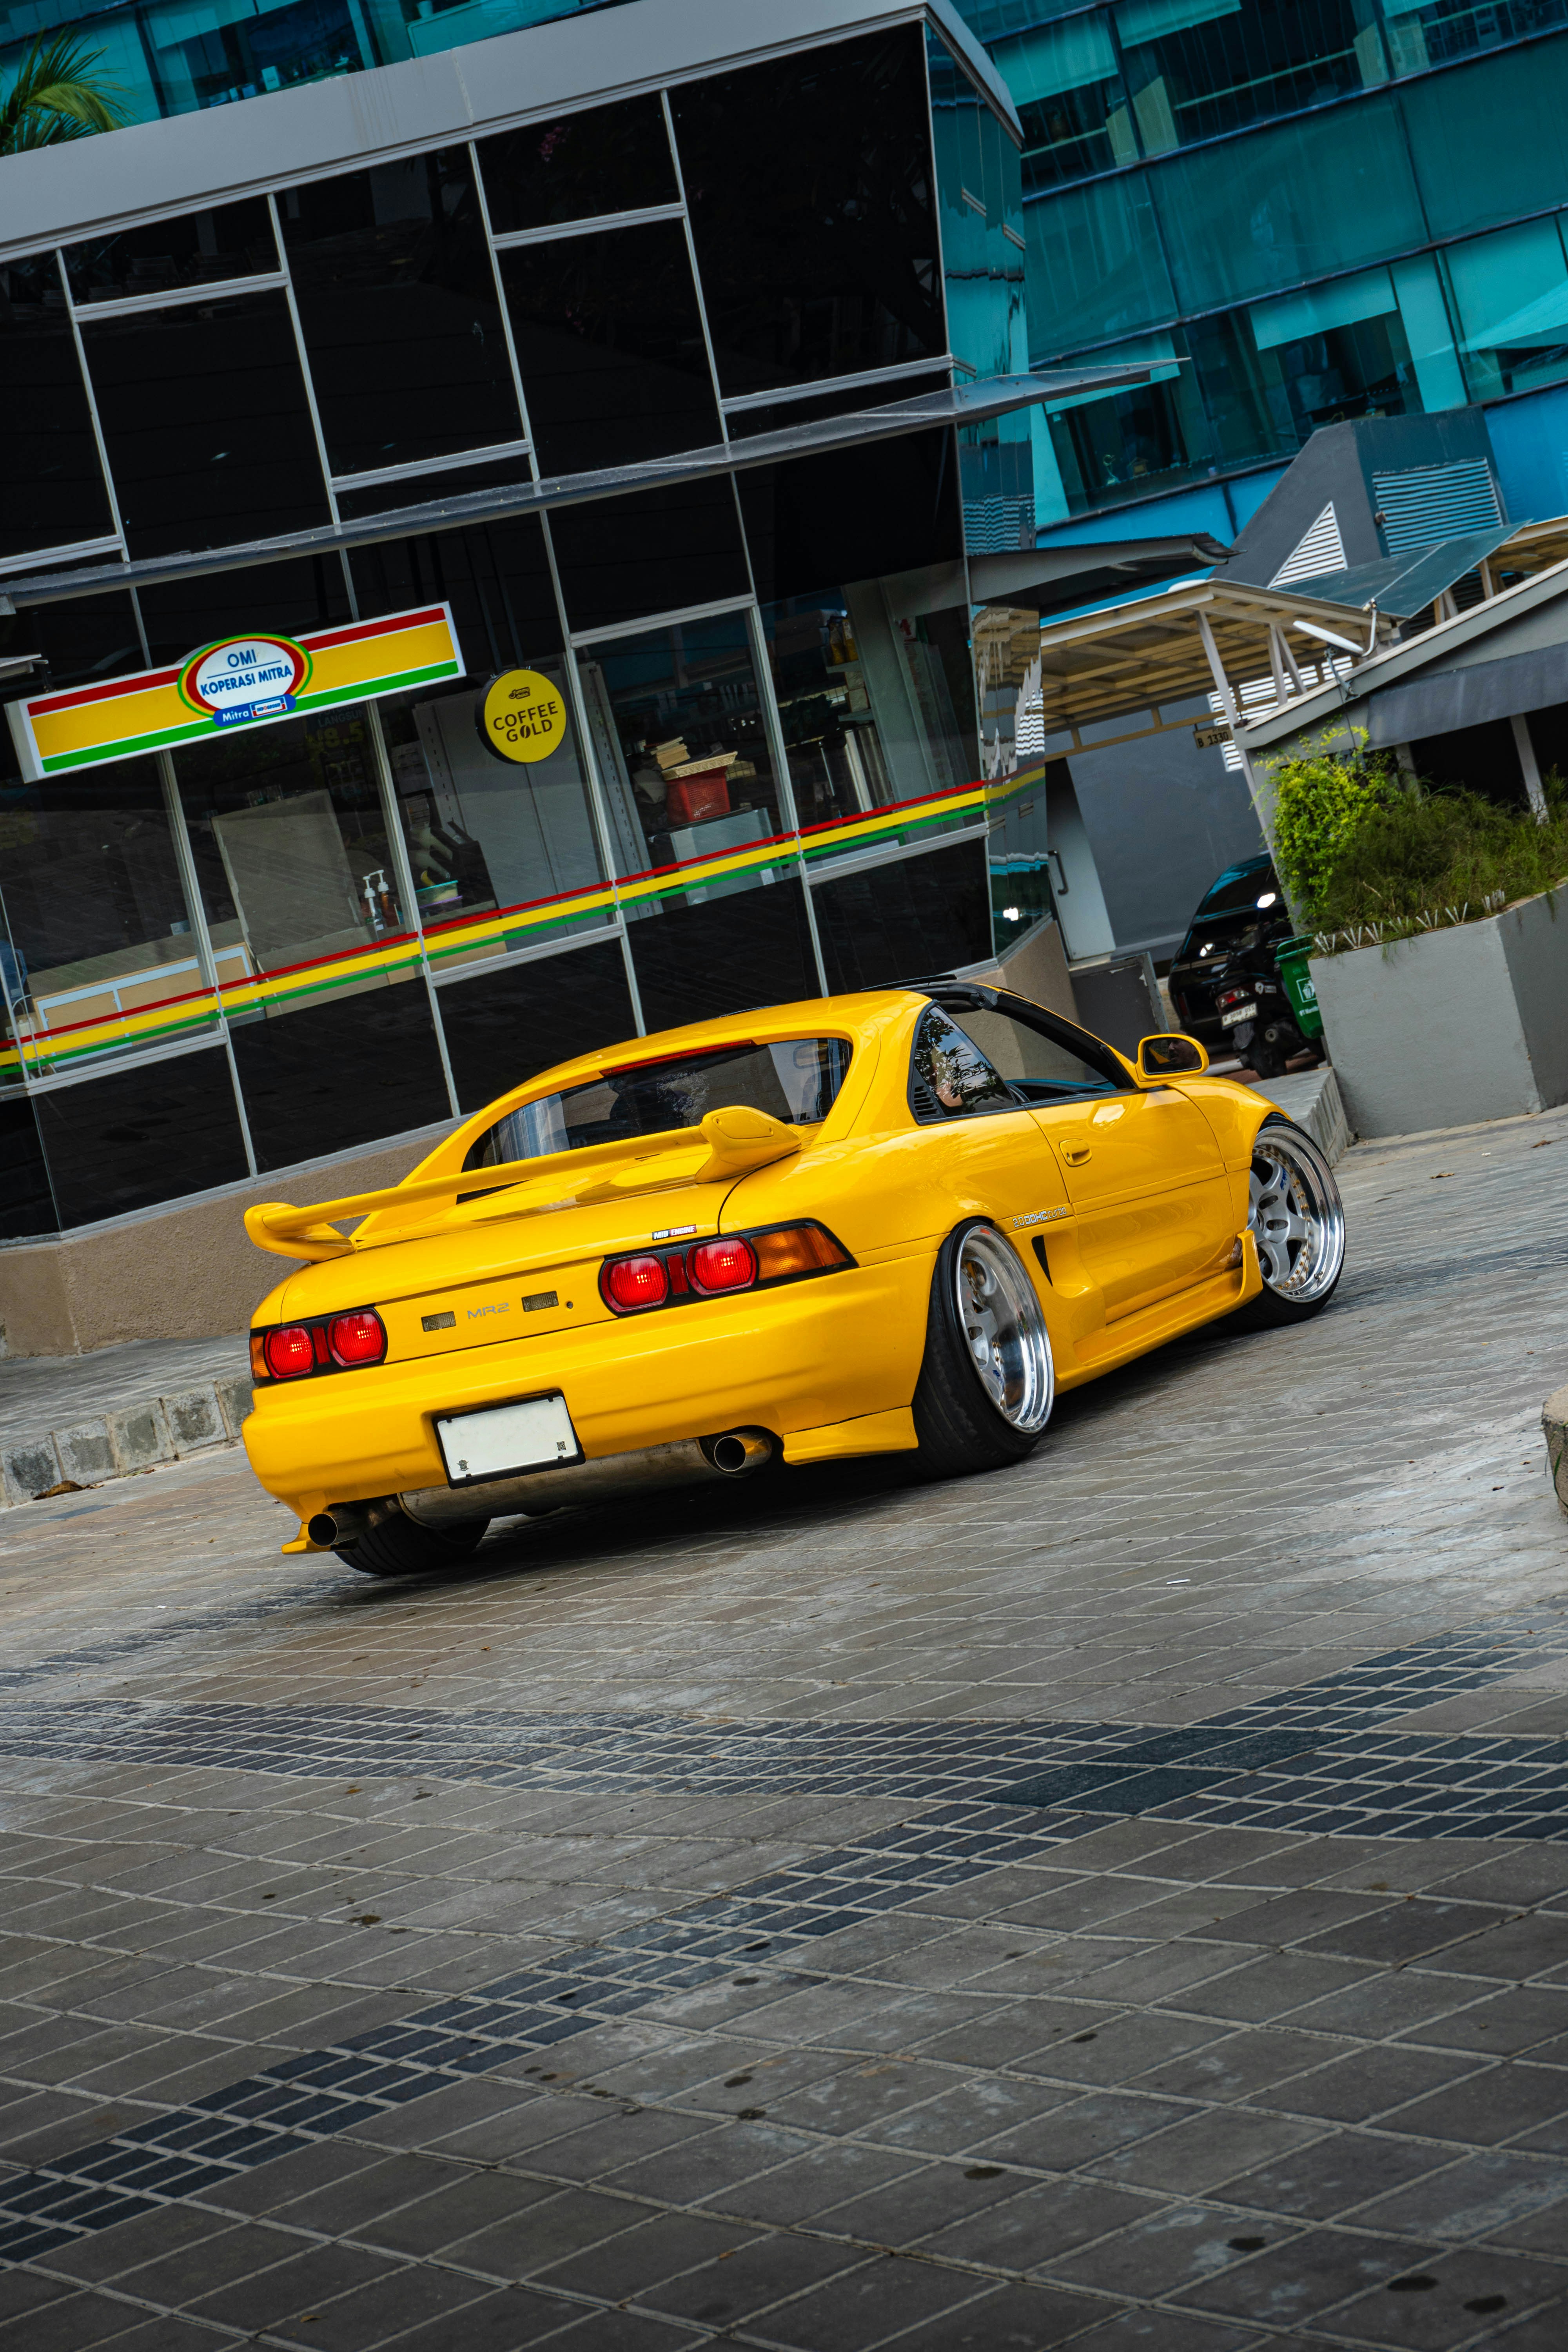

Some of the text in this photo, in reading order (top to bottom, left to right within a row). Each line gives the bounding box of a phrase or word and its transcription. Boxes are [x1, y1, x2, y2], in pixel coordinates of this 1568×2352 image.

[227, 649, 257, 668] OMI
[200, 665, 292, 696] KOPERASI MITRA
[223, 711, 249, 722] Mitra
[493, 701, 558, 731] COFFEE
[506, 719, 553, 742] GOLD
[1198, 731, 1229, 747] B 1330
[654, 1225, 695, 1240] MID ENGINE
[467, 1303, 510, 1319] MR2
